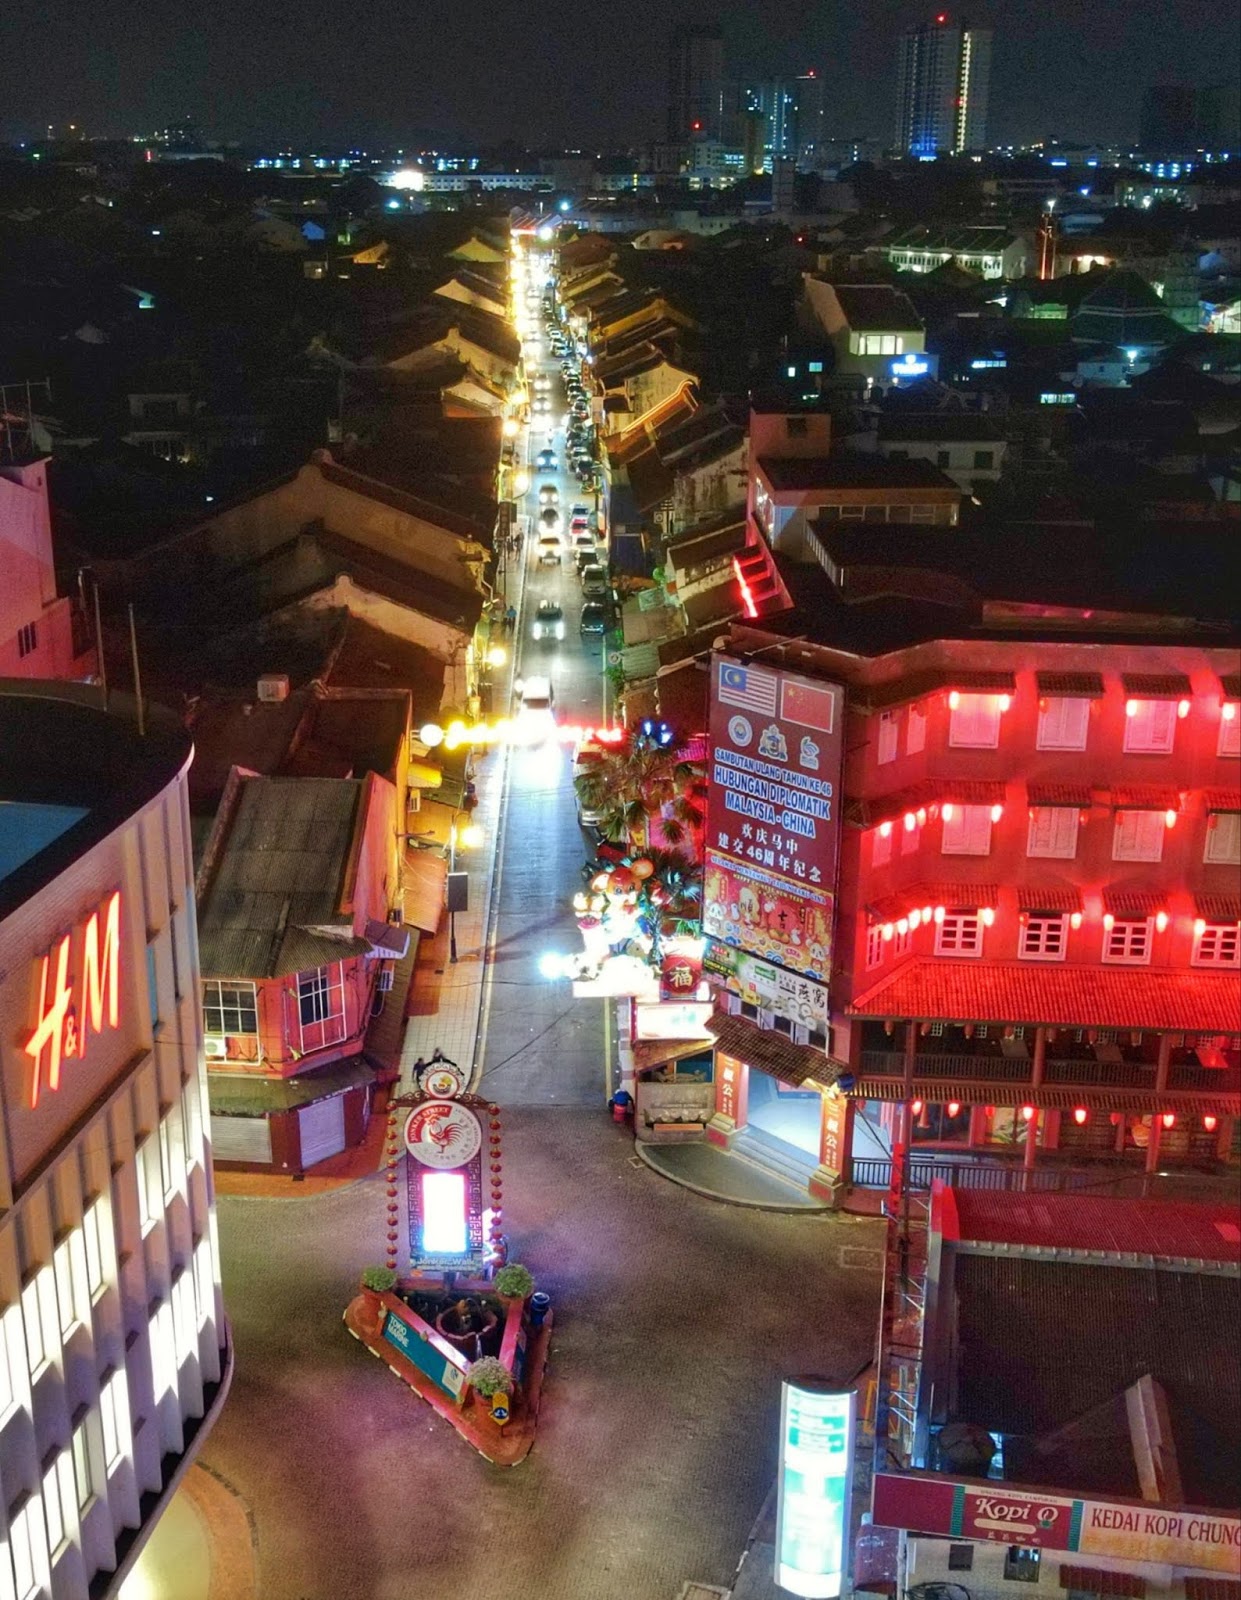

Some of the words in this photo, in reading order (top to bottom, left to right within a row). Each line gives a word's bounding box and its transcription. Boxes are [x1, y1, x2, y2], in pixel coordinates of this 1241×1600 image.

[714, 764, 768, 800] HUBUNGAN
[769, 783, 830, 820] DIPLOMATIK
[715, 747, 755, 773] SAMBUTAN
[755, 760, 781, 781] ULANG
[782, 768, 807, 789] TAHUN
[808, 777, 821, 794] KE
[821, 782, 832, 797] 46
[726, 790, 775, 825] MALAYSIA
[782, 810, 816, 839] CHINA
[742, 823, 798, 855] 欢庆马中
[669, 966, 693, 988] 福
[24, 890, 120, 1109] H&M
[976, 1498, 1032, 1521] Kopi
[1091, 1507, 1140, 1532] KEDAI
[1144, 1515, 1183, 1538] KOPI
